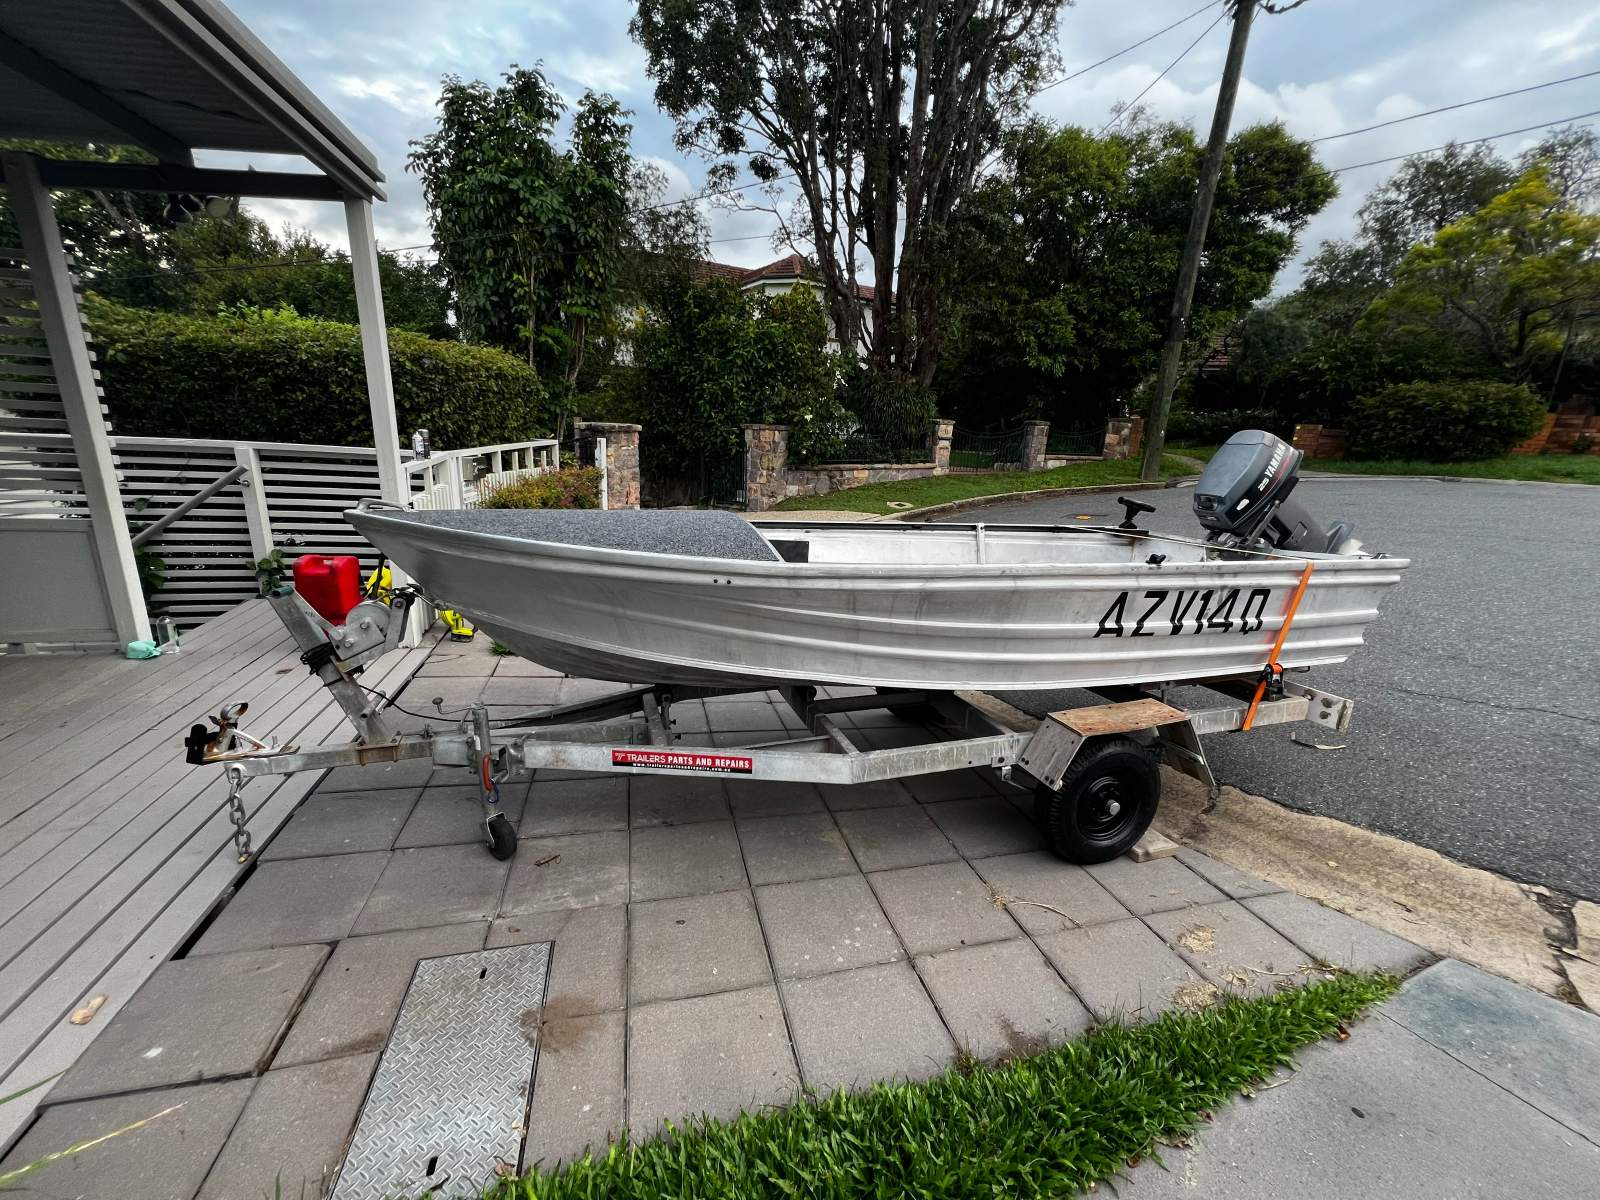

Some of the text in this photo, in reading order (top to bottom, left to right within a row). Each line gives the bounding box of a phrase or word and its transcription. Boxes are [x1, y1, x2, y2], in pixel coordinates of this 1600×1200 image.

[1093, 588, 1271, 639] AZV140
[627, 753, 750, 769] TRAILERS PARTS AND REPAIRS
